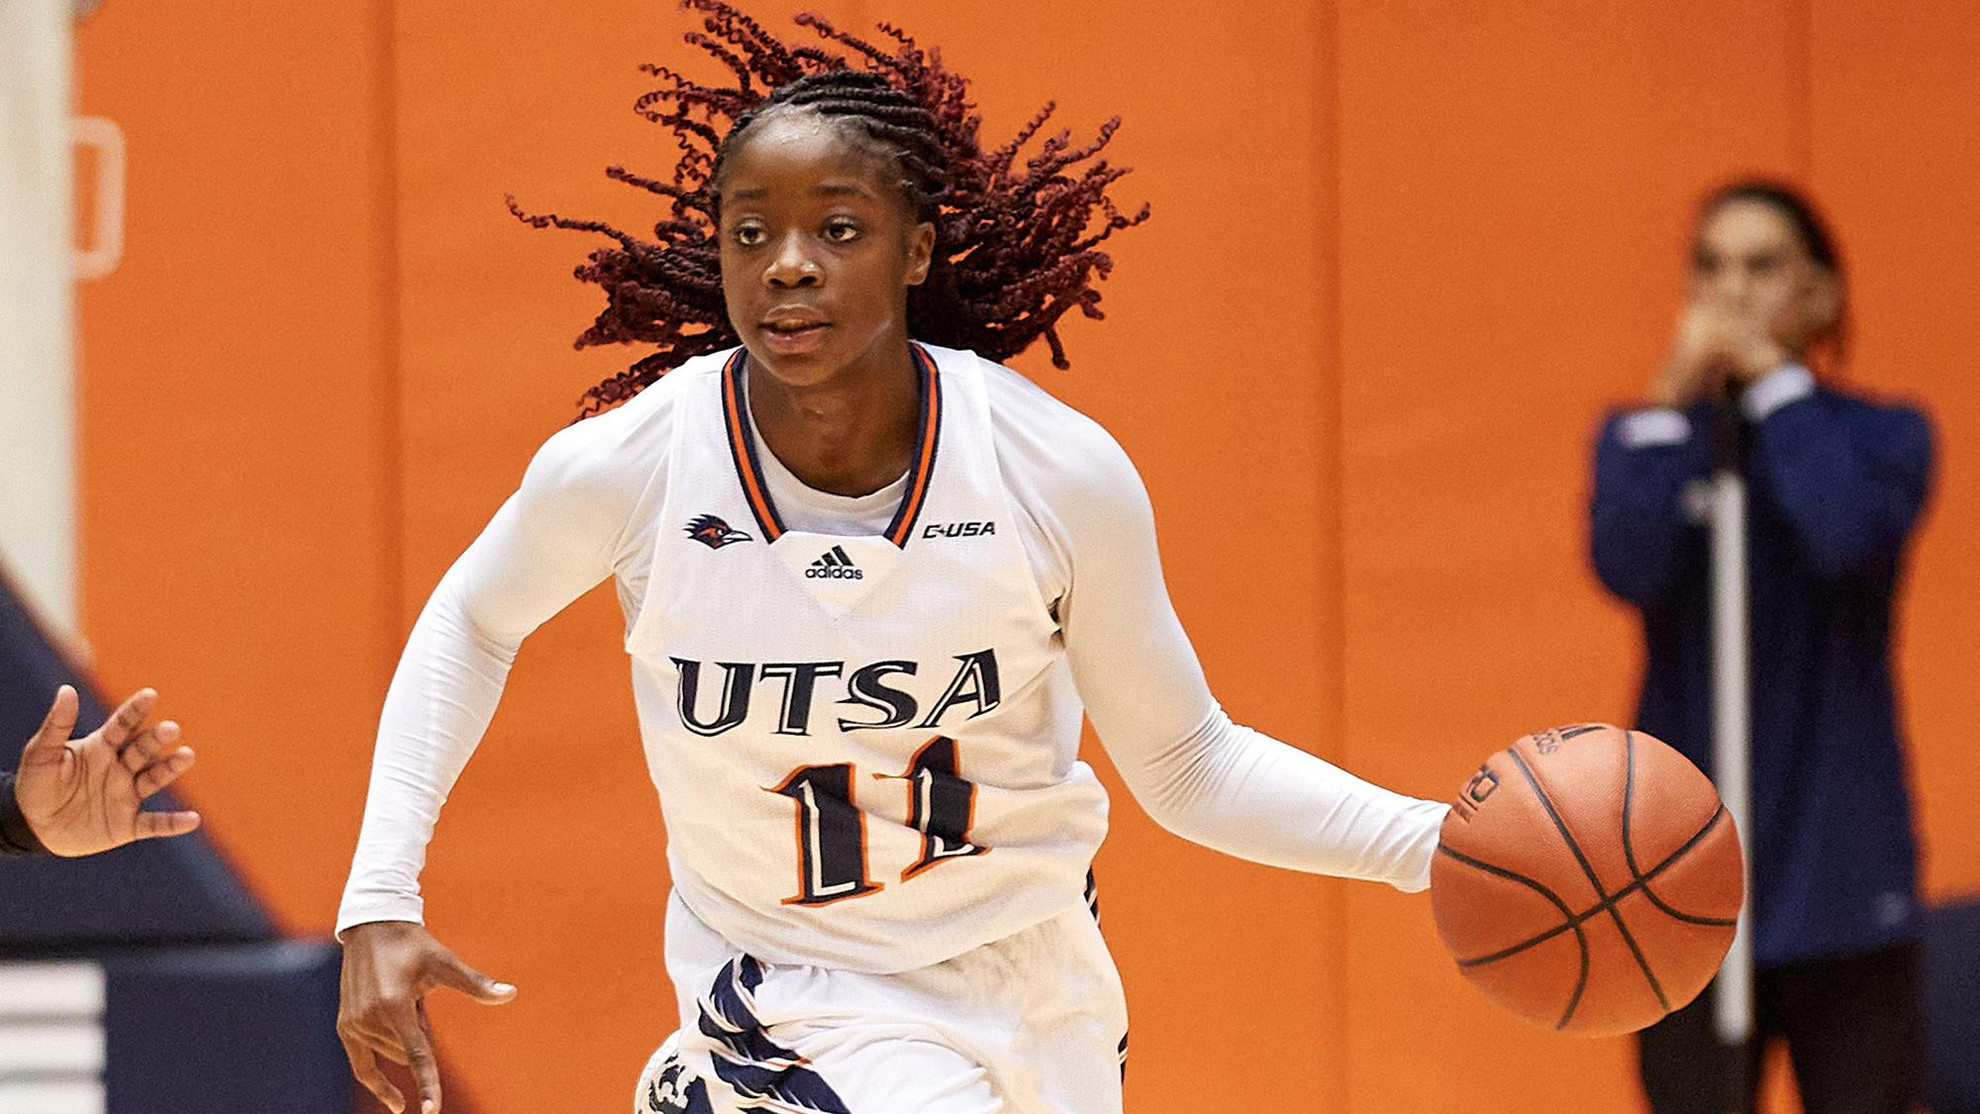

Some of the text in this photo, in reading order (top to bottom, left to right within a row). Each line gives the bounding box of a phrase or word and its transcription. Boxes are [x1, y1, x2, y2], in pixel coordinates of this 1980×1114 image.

[805, 565, 863, 580] adidas
[668, 648, 1001, 737] UTSA
[760, 735, 993, 907] 11
